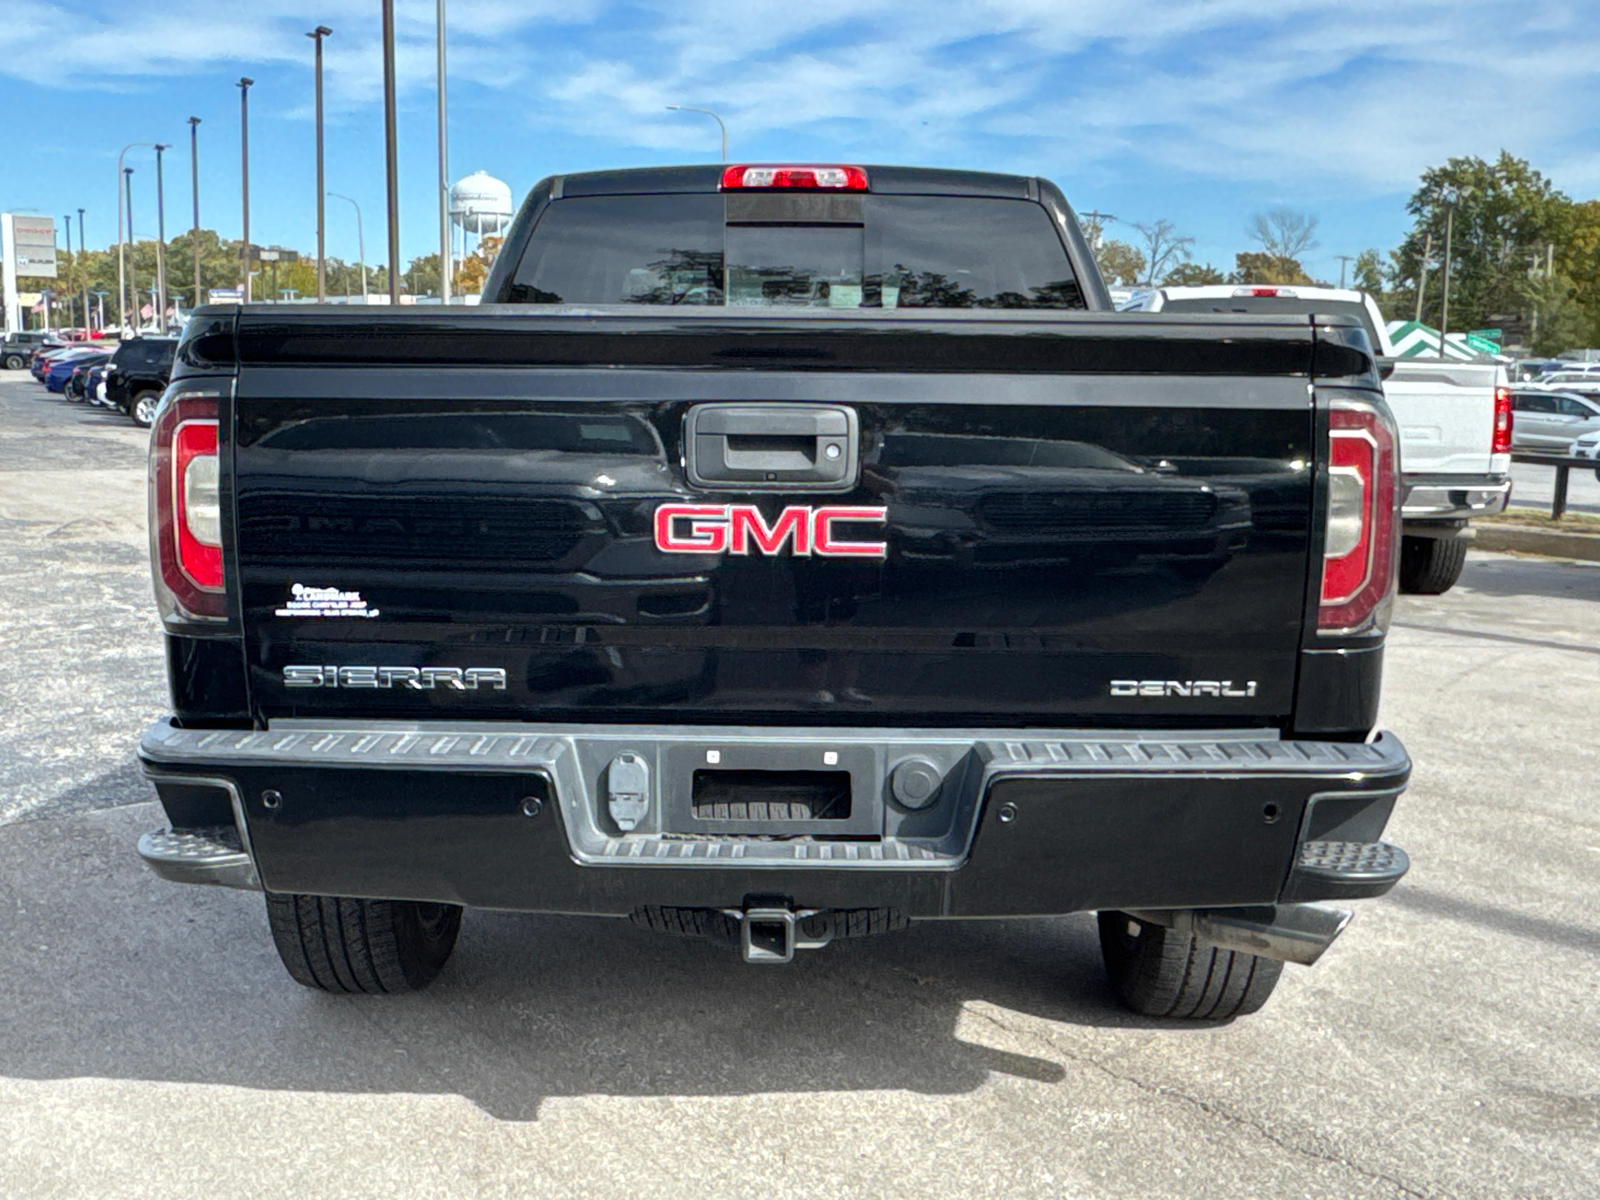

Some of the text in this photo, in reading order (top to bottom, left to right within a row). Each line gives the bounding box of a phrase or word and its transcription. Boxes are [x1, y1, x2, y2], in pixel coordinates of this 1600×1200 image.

[653, 503, 888, 557] GMC
[283, 665, 507, 690] SIERRA
[1110, 680, 1257, 697] DENALI
